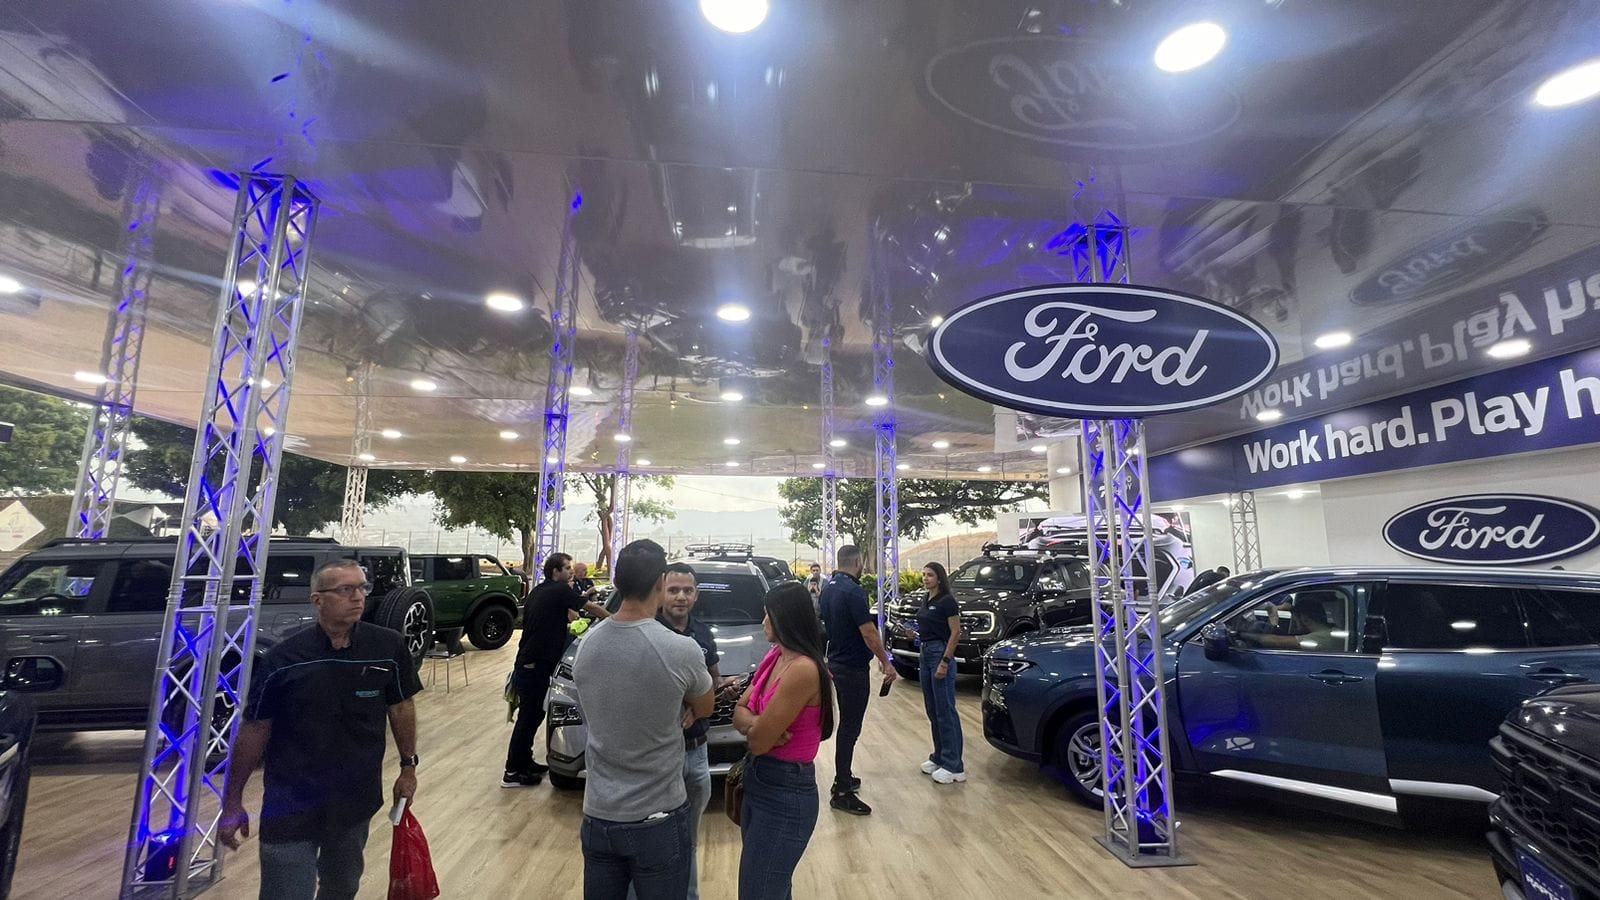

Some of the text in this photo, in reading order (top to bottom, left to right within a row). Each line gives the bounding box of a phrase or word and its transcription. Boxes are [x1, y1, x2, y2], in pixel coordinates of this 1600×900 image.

[1003, 301, 1210, 387] Ford
[1243, 428, 1322, 474] Work
[1324, 406, 1430, 460] hard.
[1430, 386, 1550, 437] Play
[1418, 505, 1546, 550] Ford
